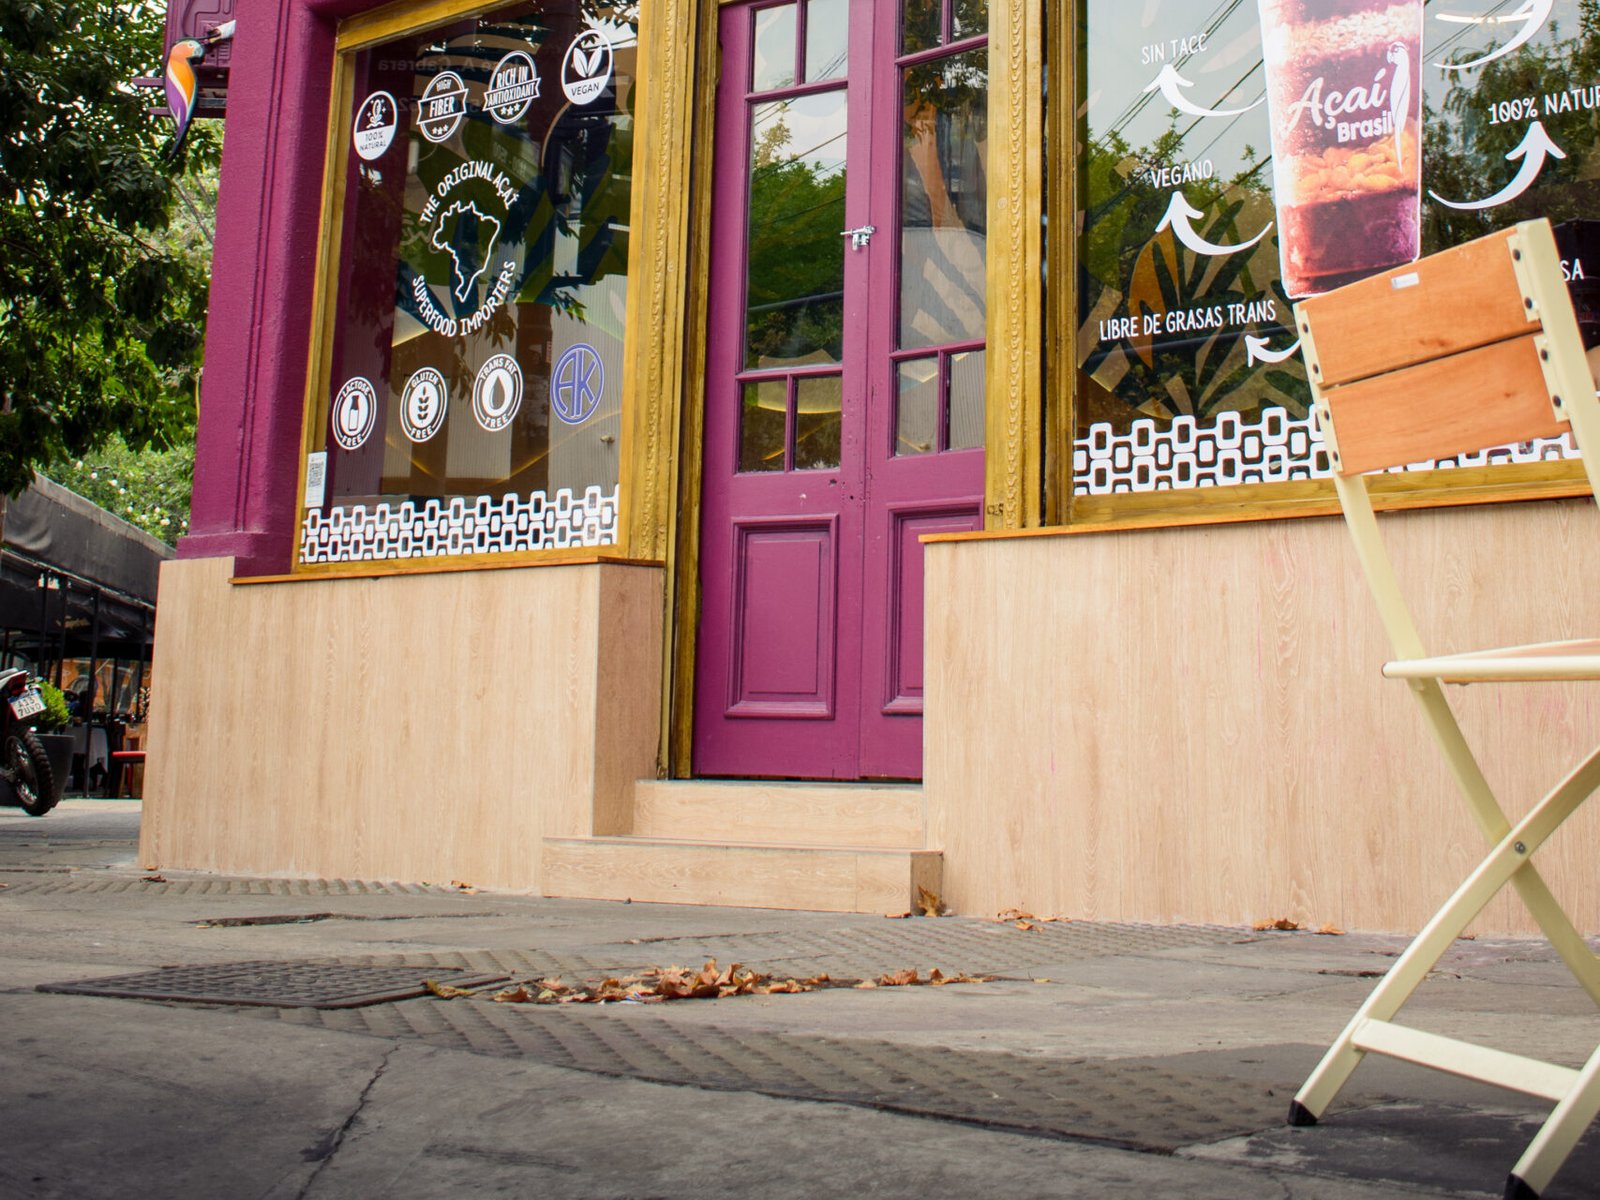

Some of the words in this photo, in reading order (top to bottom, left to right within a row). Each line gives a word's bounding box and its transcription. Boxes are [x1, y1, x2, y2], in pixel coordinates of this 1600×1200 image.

[1141, 40, 1165, 65] SIN
[1170, 32, 1208, 59] TACC
[436, 79, 452, 92] HIGH
[496, 67, 516, 89] RICH
[518, 66, 529, 83] IN
[571, 82, 600, 96] VEGAN
[487, 82, 535, 106] ANTIOXIDANT
[1285, 67, 1387, 131] Açaí
[429, 96, 455, 118] FIBER
[1487, 96, 1539, 125] 100%
[365, 131, 383, 141] 100%
[1337, 111, 1393, 143] Brasil
[360, 139, 386, 151] NATURAL
[1150, 158, 1213, 189] VEGANO
[419, 194, 440, 224] THE
[437, 160, 494, 197] ORIGINAL
[412, 274, 457, 337] SUPERFOOD
[459, 260, 516, 337] IMPORTERS
[1100, 315, 1139, 341] LIBRE
[1143, 313, 1162, 335] DE
[1165, 307, 1223, 333] GRASAS
[1227, 299, 1276, 325] TRANS
[410, 371, 439, 387] GLUTEN
[480, 357, 504, 381] TRANS
[504, 358, 518, 373] FAT
[342, 380, 370, 398] LACTOSE
[410, 425, 433, 438] FREE
[484, 413, 509, 428] FREE
[341, 434, 363, 447] FREE
